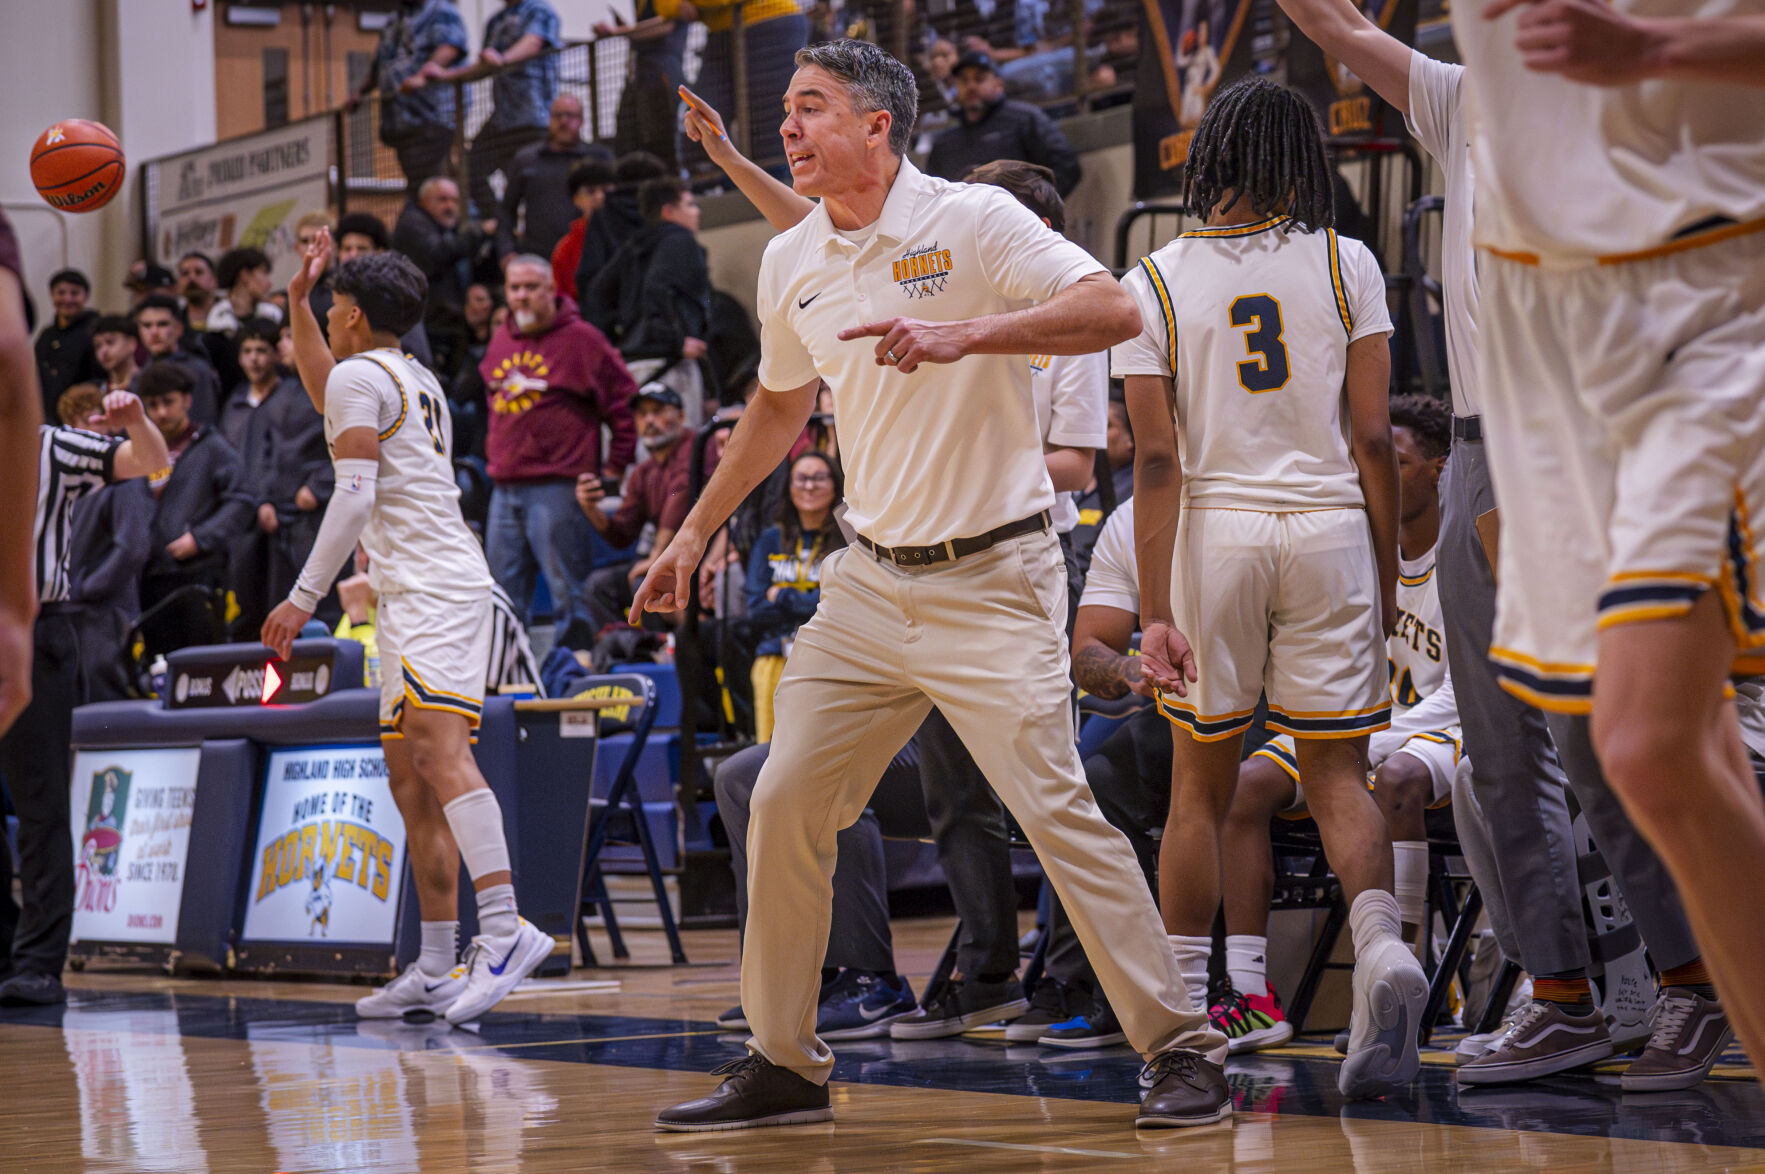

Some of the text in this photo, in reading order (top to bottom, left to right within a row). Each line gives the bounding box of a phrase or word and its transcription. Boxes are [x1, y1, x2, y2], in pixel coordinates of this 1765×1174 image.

[45, 181, 106, 207] Wilson
[902, 241, 938, 258] Highland
[892, 249, 953, 283] HORNETS
[1228, 292, 1292, 394] 3
[283, 760, 330, 782] HIGHLAND
[333, 757, 357, 779] HIGH
[292, 791, 373, 824] HOME OF THE
[127, 862, 154, 882] SINCE
[256, 820, 394, 905] HORNETS
